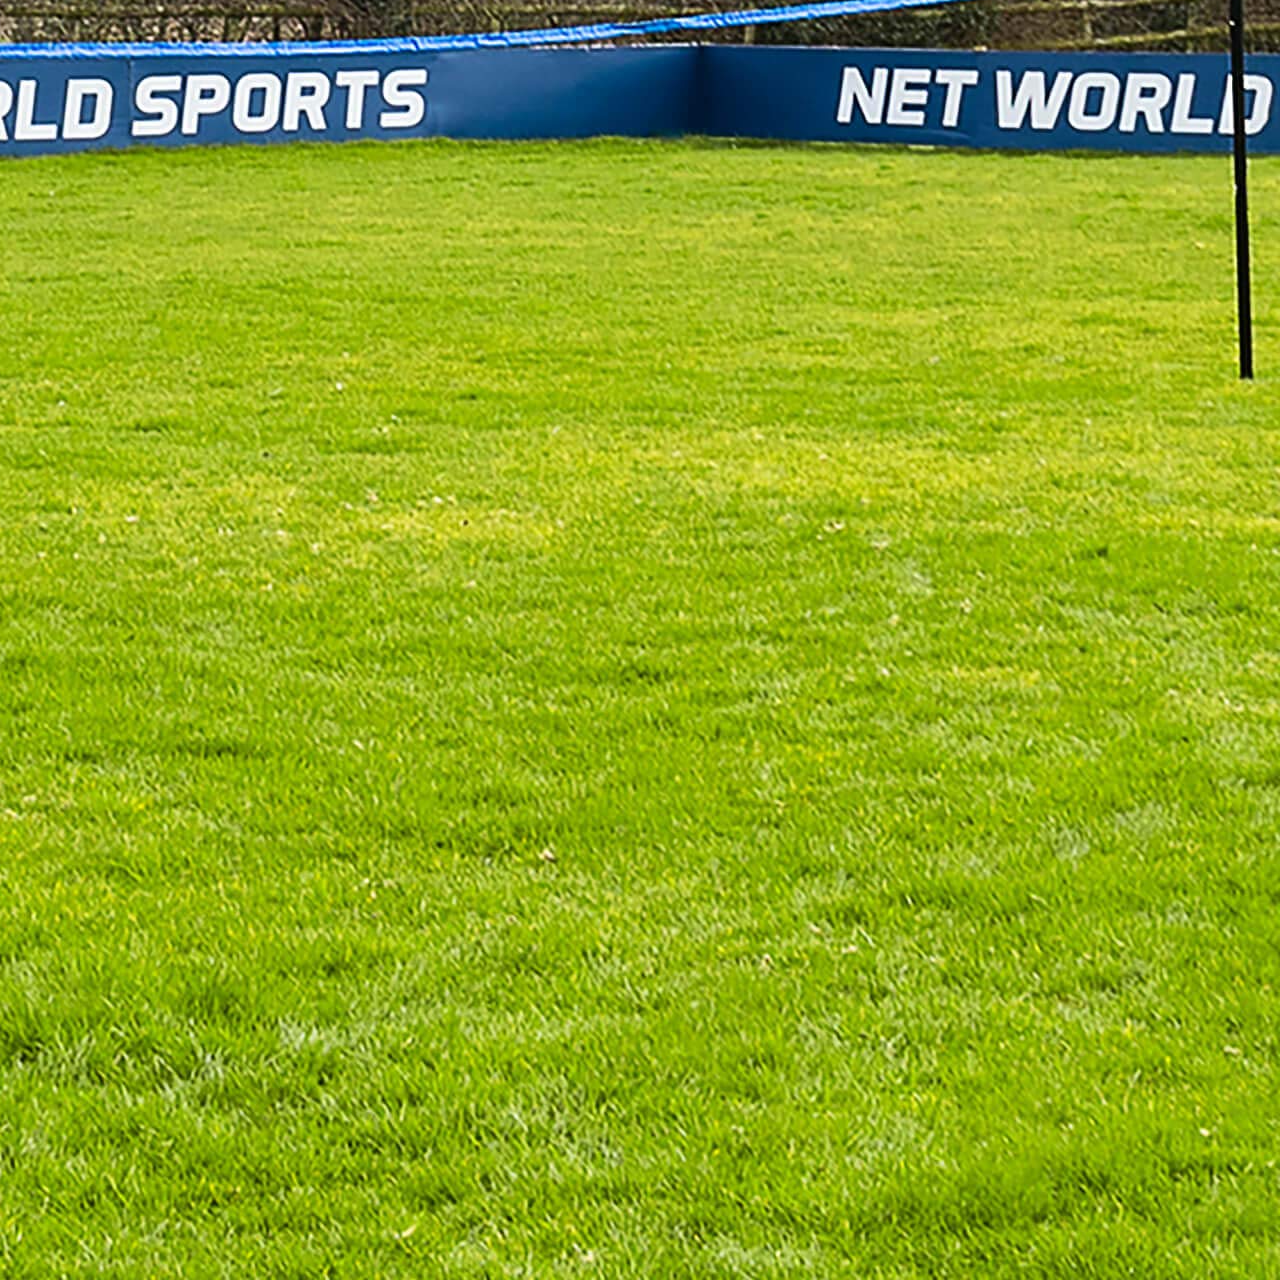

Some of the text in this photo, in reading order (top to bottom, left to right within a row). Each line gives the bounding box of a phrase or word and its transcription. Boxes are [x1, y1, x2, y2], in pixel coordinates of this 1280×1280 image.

[131, 70, 427, 137] SPORTS
[837, 67, 1273, 135] NET WORLD
